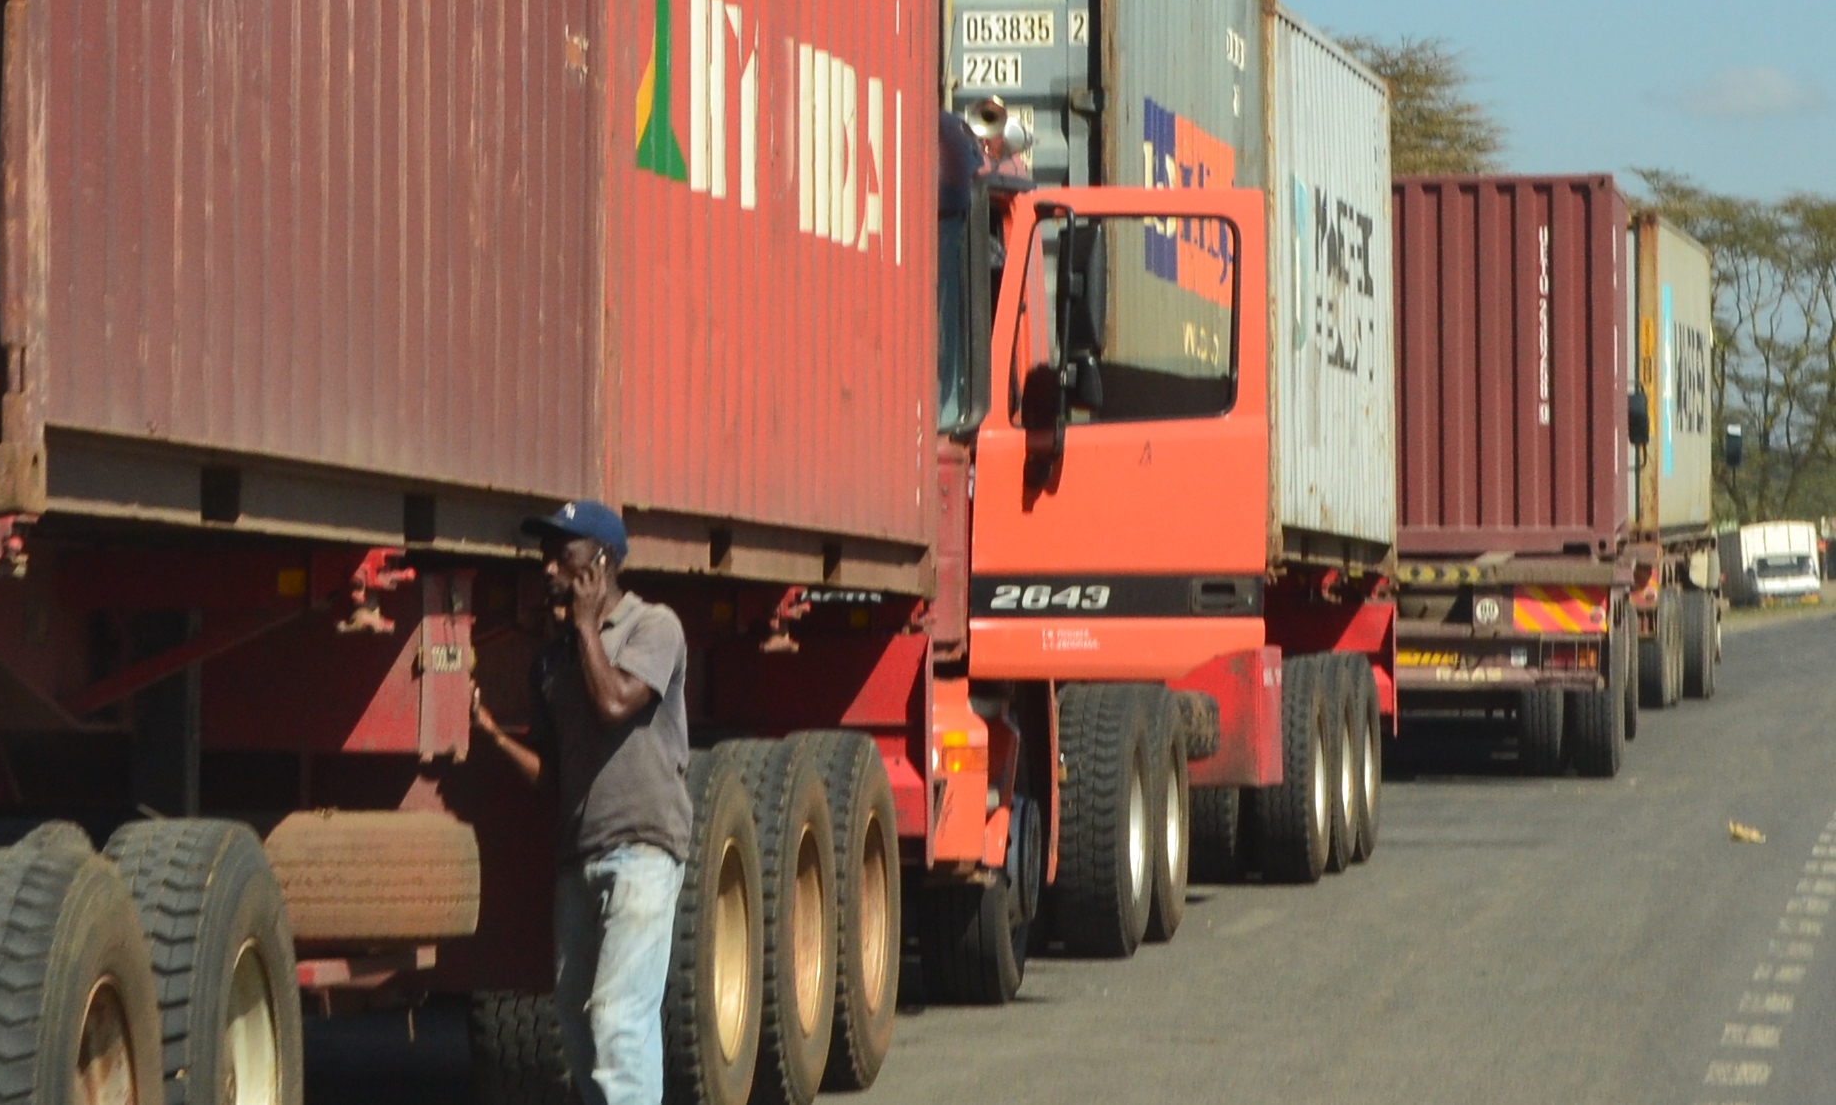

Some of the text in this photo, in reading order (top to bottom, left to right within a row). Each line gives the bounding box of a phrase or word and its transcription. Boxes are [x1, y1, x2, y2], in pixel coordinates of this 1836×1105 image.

[966, 13, 1085, 43] 053835 2
[966, 57, 1019, 84] 22G1
